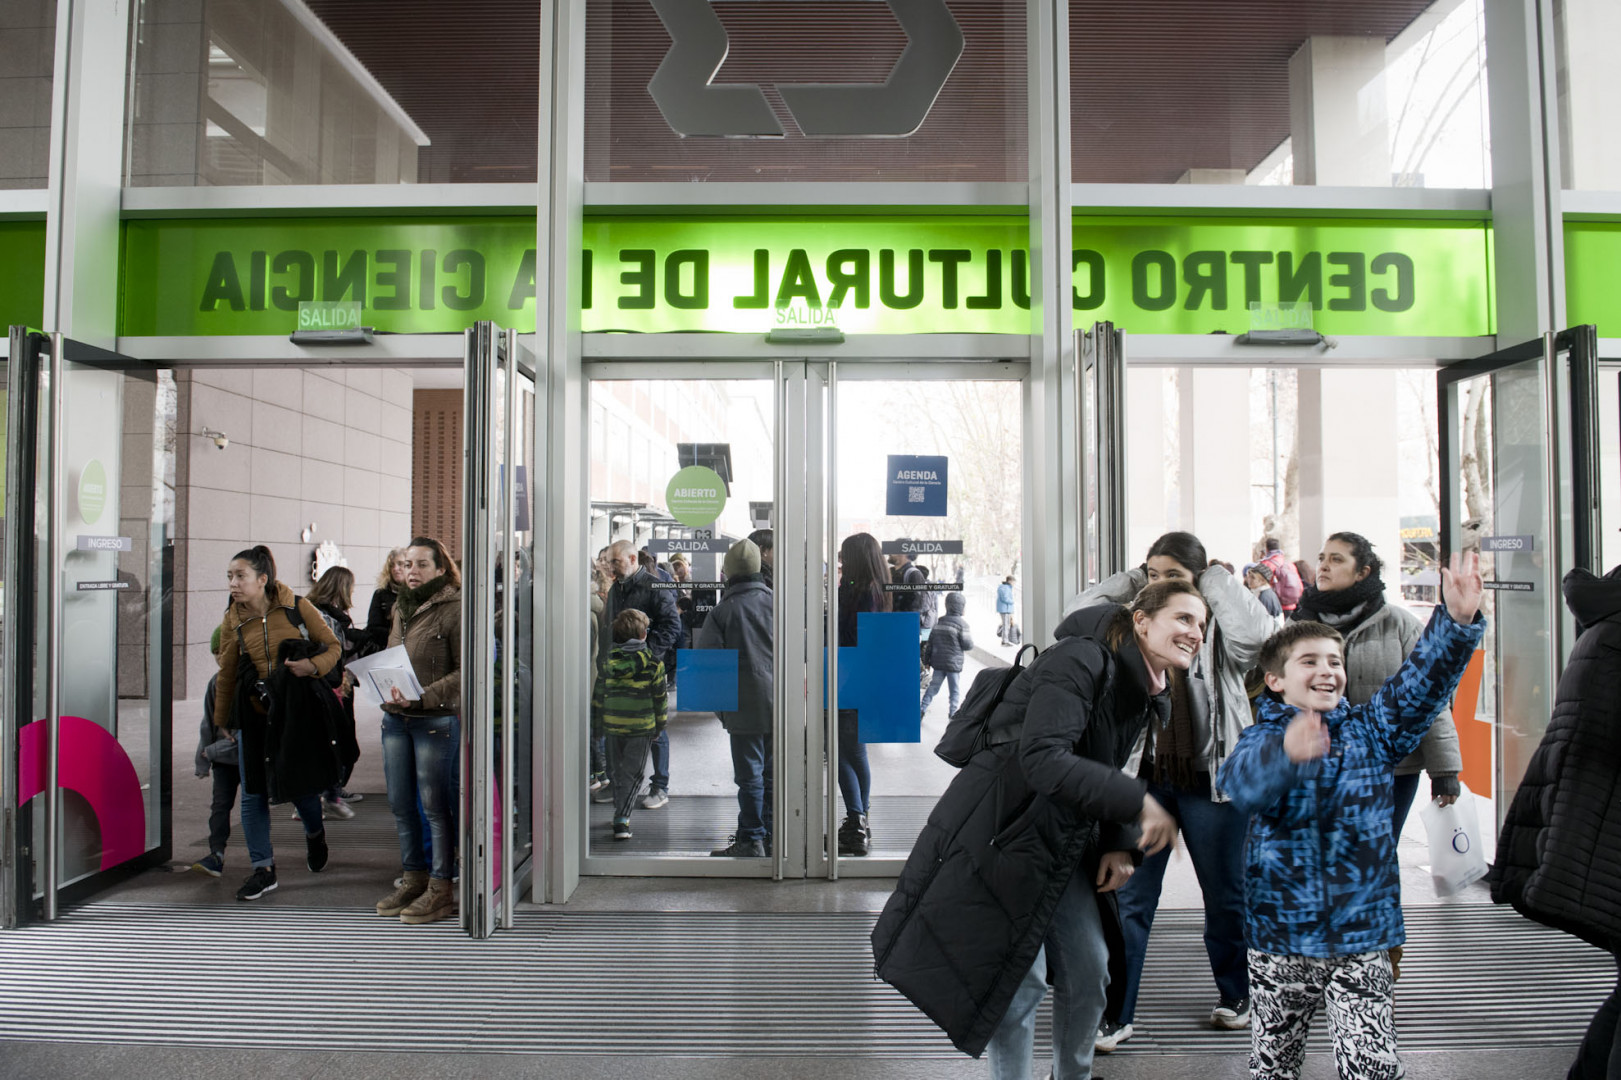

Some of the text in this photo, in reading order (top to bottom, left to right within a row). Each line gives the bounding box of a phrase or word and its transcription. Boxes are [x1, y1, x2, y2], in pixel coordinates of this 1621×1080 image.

[300, 308, 358, 327] SALIDA
[775, 306, 836, 325] SALIDA
[896, 470, 938, 481] AGENDA
[673, 487, 717, 499] ABIERTO
[87, 538, 123, 549] INGRESO
[667, 541, 710, 551] SALIDA
[901, 543, 944, 553] SALIDA
[1489, 538, 1523, 550] INGRESO
